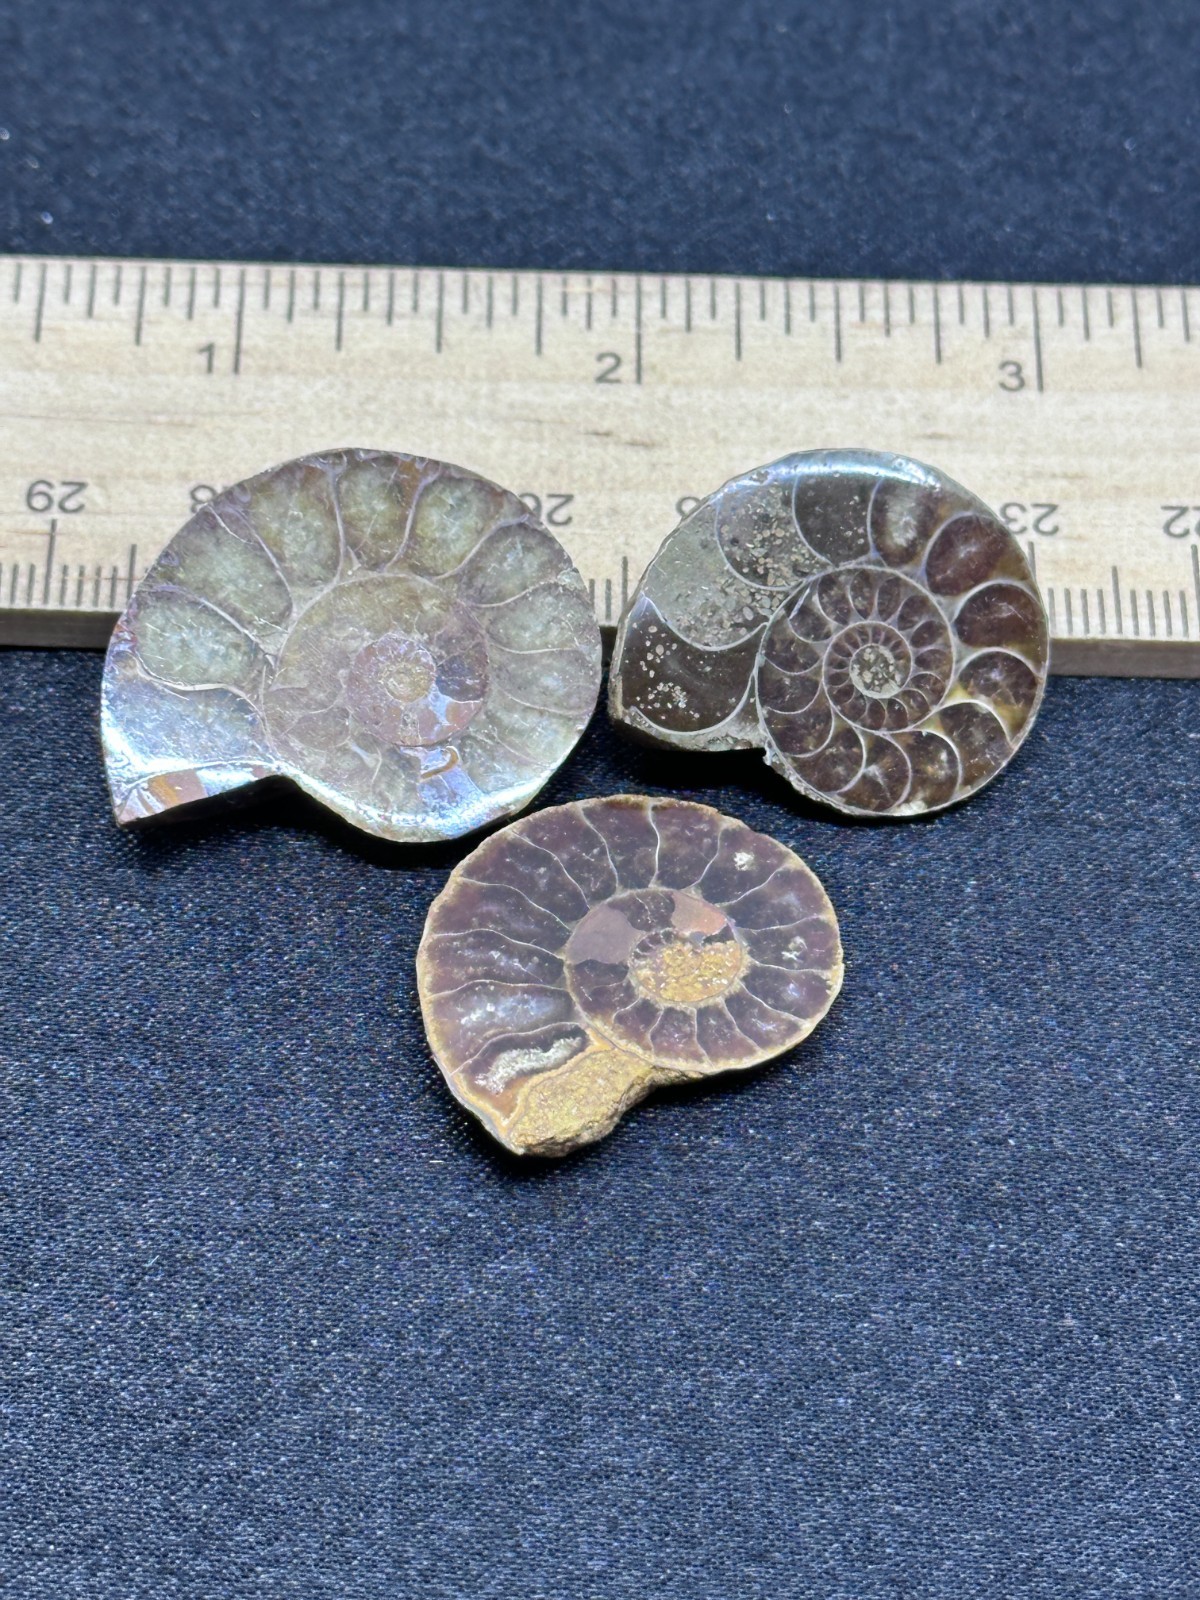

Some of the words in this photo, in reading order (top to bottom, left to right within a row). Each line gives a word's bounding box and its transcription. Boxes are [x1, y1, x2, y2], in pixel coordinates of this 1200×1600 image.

[198, 343, 214, 375] 1
[595, 352, 622, 384] 2
[998, 360, 1026, 392] 3
[26, 479, 88, 514] 29
[1000, 502, 1059, 536] 23
[1160, 505, 1200, 538] 2
